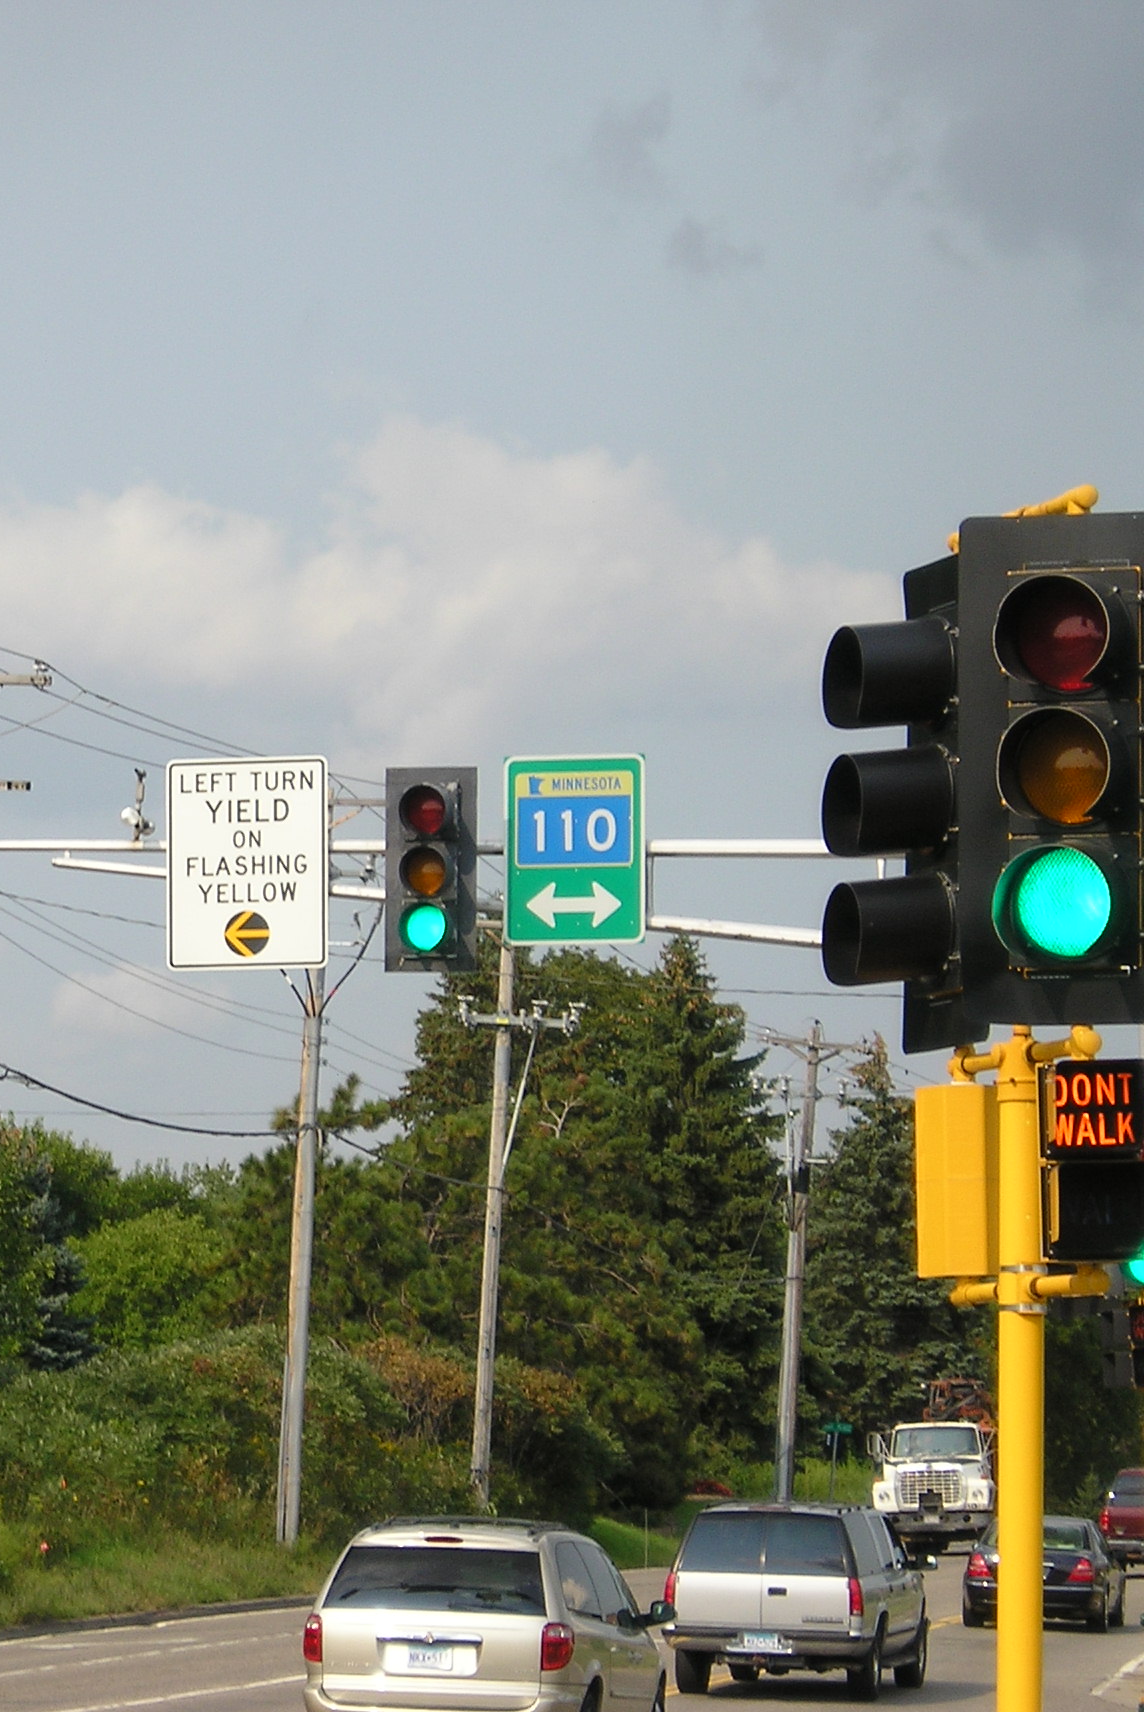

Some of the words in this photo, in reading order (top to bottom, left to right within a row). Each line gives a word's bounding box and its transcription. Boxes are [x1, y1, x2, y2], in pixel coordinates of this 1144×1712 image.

[180, 772, 237, 794] LEFT
[250, 769, 314, 792] TURN
[551, 776, 622, 791] MINNESOTA
[205, 798, 290, 824] YIELD
[232, 829, 262, 849] ON
[533, 807, 617, 853] 110
[186, 853, 308, 877] FLASHING
[198, 881, 297, 904] YELLOW
[1054, 1072, 1133, 1107] DONT
[1054, 1111, 1136, 1146] WALK
